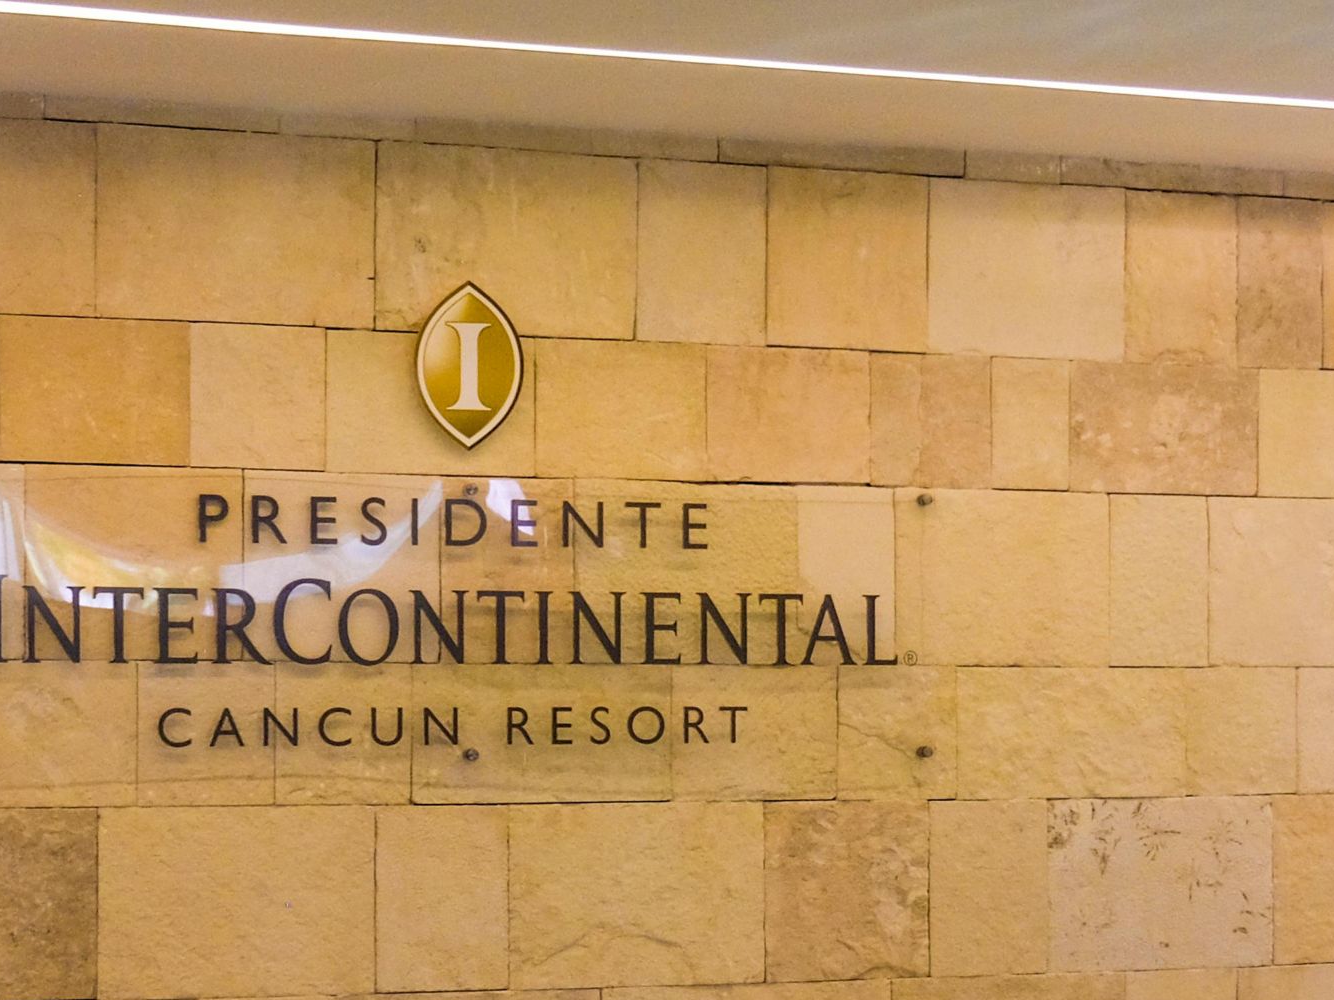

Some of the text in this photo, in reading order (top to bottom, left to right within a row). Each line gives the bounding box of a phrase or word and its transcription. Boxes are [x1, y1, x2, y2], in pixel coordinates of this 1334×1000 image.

[198, 494, 709, 550] PRESIDENTE
[157, 706, 749, 748] CANCUN RESORT
